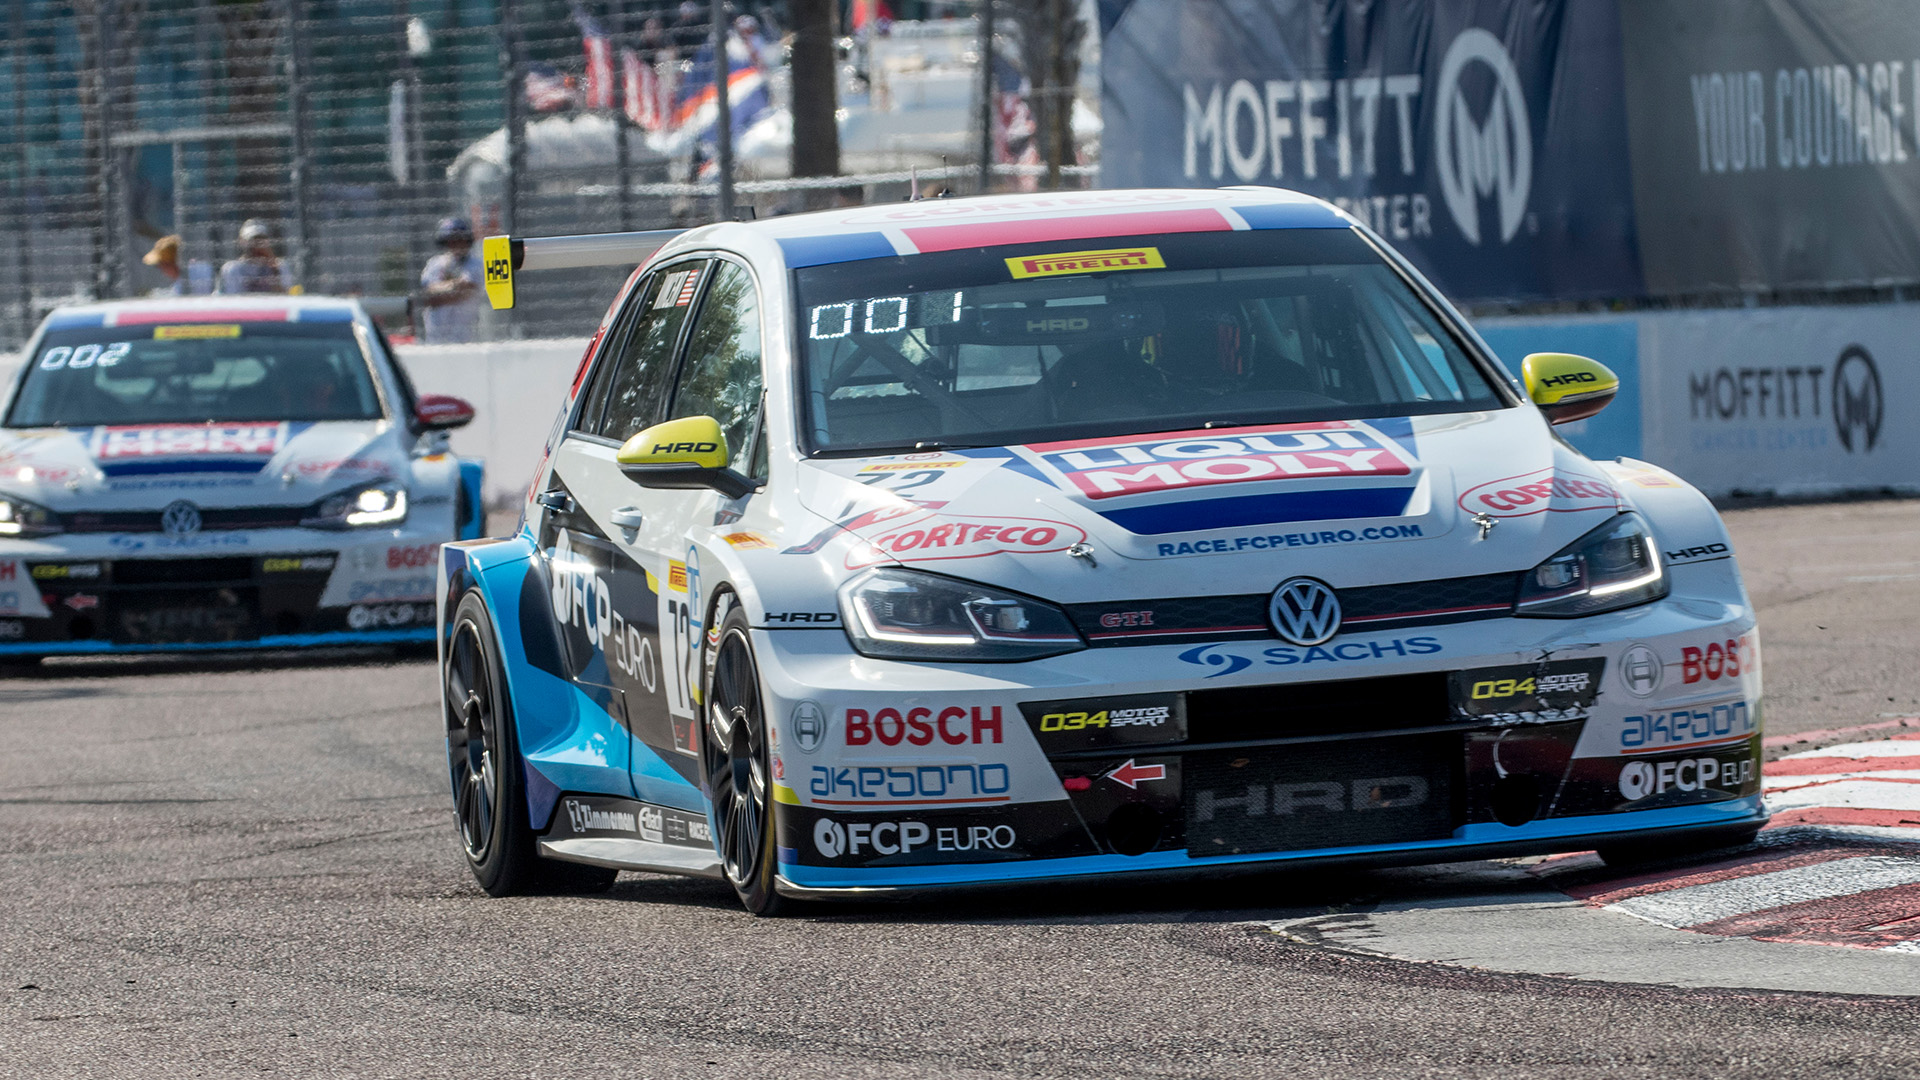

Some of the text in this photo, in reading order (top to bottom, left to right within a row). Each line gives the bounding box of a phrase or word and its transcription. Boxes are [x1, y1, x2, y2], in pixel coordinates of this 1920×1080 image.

[1183, 74, 1422, 180] MOFFITT
[1690, 71, 1767, 173] YOUR
[1776, 60, 1908, 169] COURAGE
[886, 192, 1187, 219] CORTECO
[1343, 194, 1433, 241] NTER
[486, 259, 509, 280] HRD
[1021, 252, 1148, 274] PIRELLI
[1026, 317, 1089, 332] HRD
[39, 341, 132, 371] 002
[1540, 372, 1597, 387] HRD
[1689, 366, 1824, 421] MOFFITT
[651, 442, 718, 454] HRD
[1059, 432, 1367, 470] LIQUI
[1084, 450, 1386, 493] MOLY
[1478, 476, 1620, 511] CORTECO
[870, 523, 1058, 556] CORTECO
[1158, 523, 1424, 557] RACE.FCPEURO.COM
[1667, 542, 1729, 560] HRD
[387, 544, 438, 569] BOSC
[571, 553, 656, 694] FCP EURO
[764, 612, 838, 623] HRD
[1100, 611, 1154, 628] GTI
[1263, 636, 1443, 666] SACHS
[1681, 635, 1756, 684] BOSC
[1472, 677, 1537, 700] 034
[1536, 672, 1590, 684] MOTOR
[1537, 682, 1590, 693] SPORT
[845, 706, 1003, 746] BOSCH
[1040, 711, 1109, 732] 034
[1110, 706, 1169, 718] MOTOR
[1110, 716, 1168, 727] SPORT
[1621, 701, 1754, 746] akebon
[1656, 757, 1757, 794] FCP EURO
[1195, 776, 1429, 821] HRD
[847, 821, 1016, 856] FCP EURO
